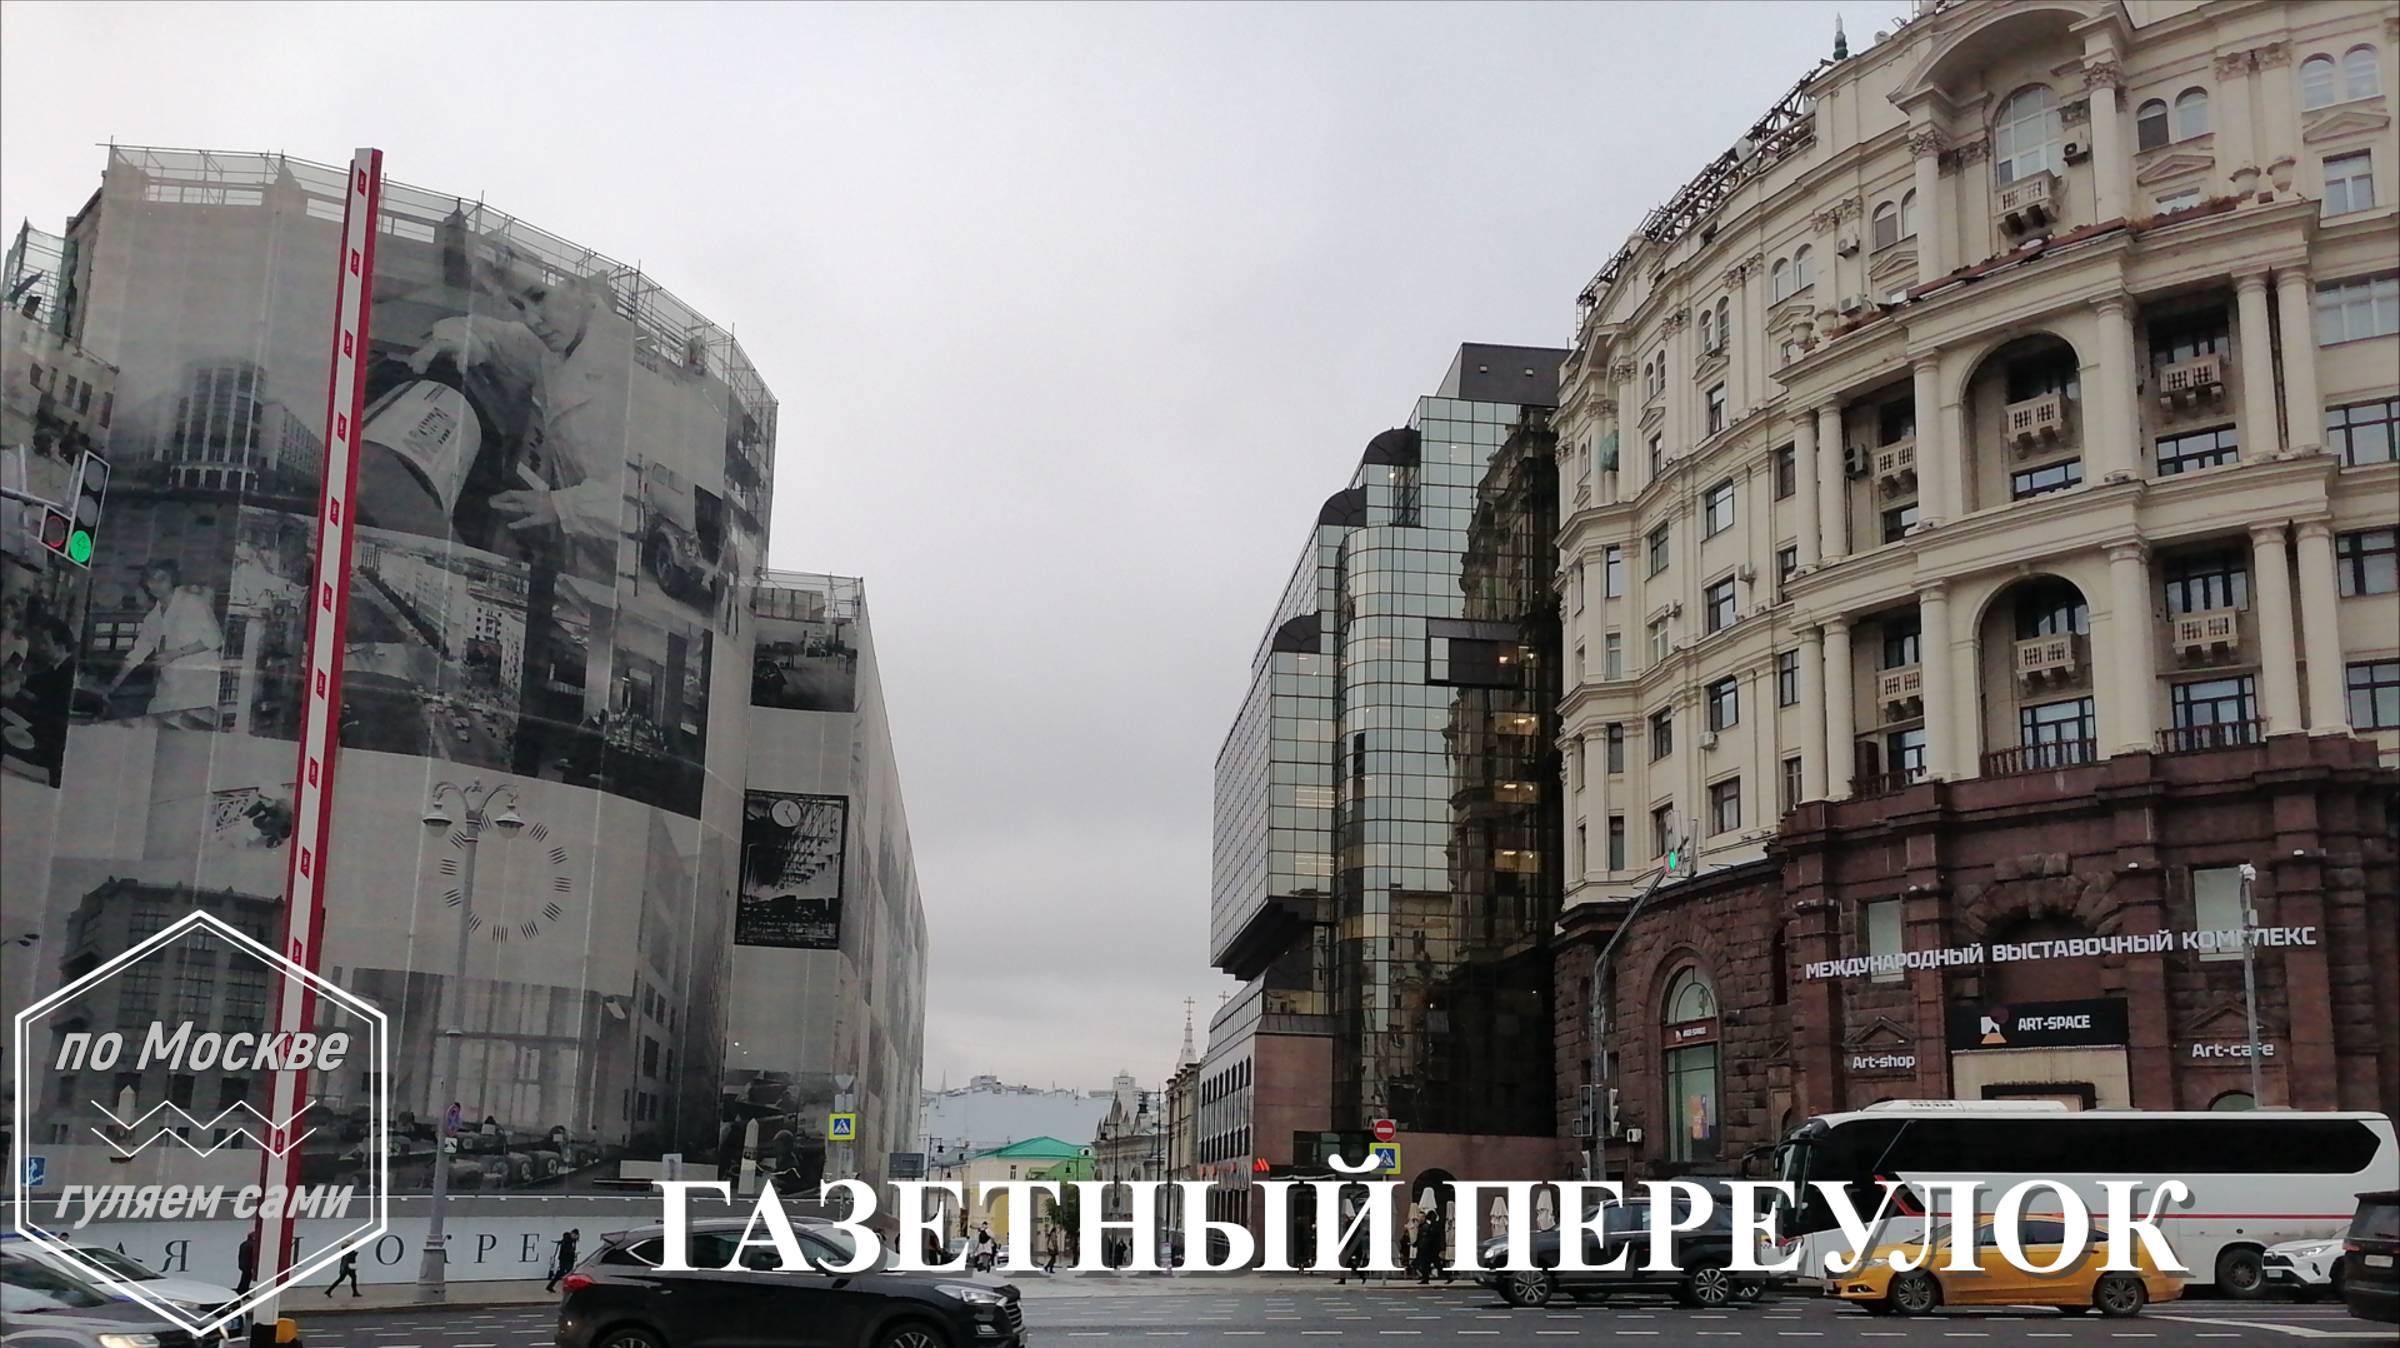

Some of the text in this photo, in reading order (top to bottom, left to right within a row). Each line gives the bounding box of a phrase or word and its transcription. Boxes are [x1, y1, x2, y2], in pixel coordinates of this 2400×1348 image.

[1805, 942, 1984, 980] МЕЖДУНАРОДНЫЙ
[1992, 929, 2173, 962] ВЫСТАВОЧНЫЙ
[2018, 1014, 2091, 1031] ART-SPACE
[1852, 1054, 1916, 1069] Art-shop
